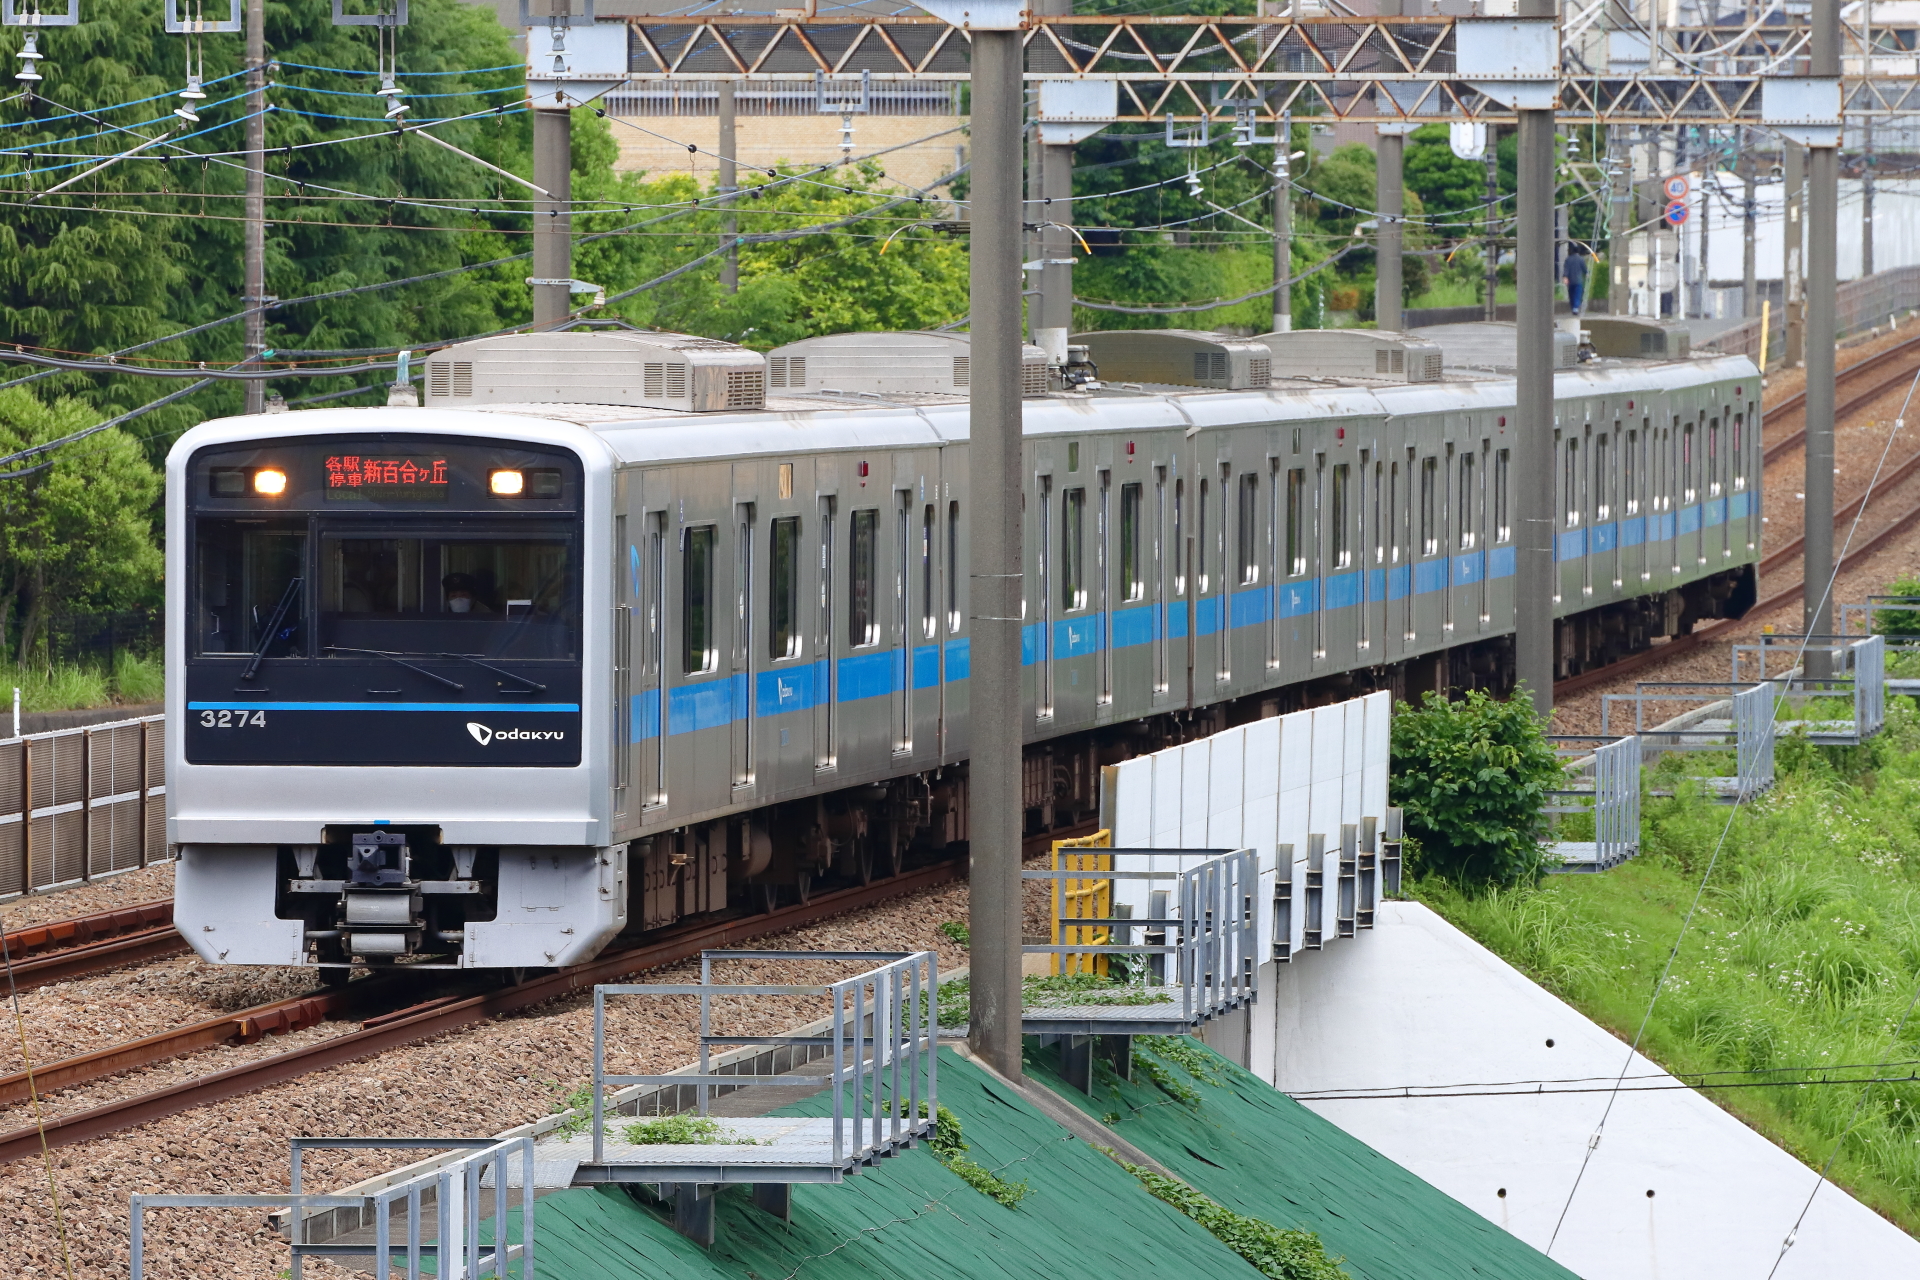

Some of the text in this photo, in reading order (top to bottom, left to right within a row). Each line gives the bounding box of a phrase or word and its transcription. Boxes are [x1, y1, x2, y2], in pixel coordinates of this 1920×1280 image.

[1671, 182, 1684, 193] 40
[325, 456, 360, 472] 各駅
[329, 472, 363, 487] 停車
[326, 489, 362, 500] Local
[200, 710, 266, 728] 3274
[495, 728, 564, 741] odakyu
